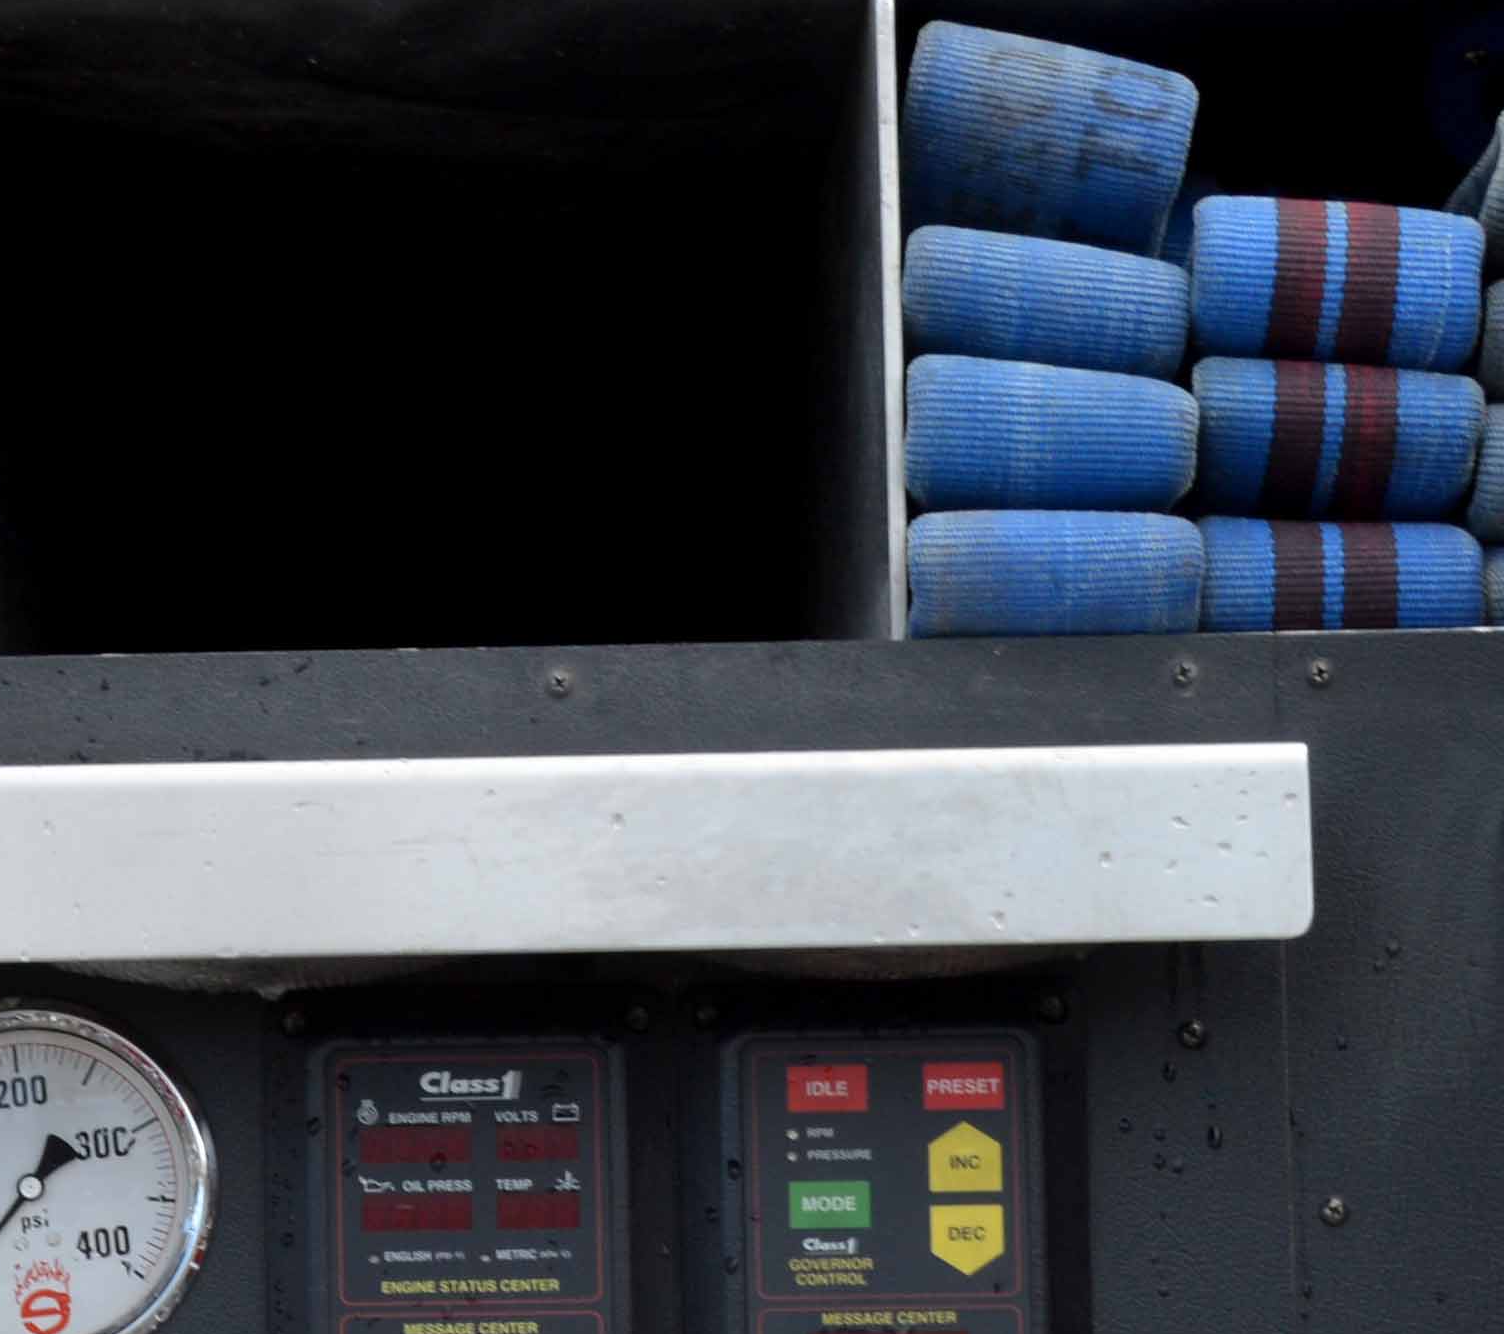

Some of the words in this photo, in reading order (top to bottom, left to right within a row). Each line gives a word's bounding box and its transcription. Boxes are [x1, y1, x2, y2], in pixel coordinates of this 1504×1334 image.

[806, 1080, 848, 1096] IDLE
[927, 1078, 1000, 1095] PRESET
[495, 1110, 538, 1123] VOLTS
[807, 1149, 873, 1161] PRESSURE
[949, 1155, 981, 1170] INC
[402, 1180, 425, 1192] OIL
[429, 1179, 472, 1192] PRESS
[496, 1179, 533, 1191] TEMP
[801, 1195, 856, 1211] MODE
[947, 1226, 986, 1241] DEC
[77, 1226, 131, 1259] 400
[789, 1258, 874, 1271] GOVERNOR
[381, 1279, 437, 1294] ENGINE
[440, 1279, 496, 1293] STATUS
[500, 1278, 560, 1293] CENTER
[796, 1272, 867, 1286] CONTROL
[821, 1311, 893, 1326] MESSAGE
[897, 1310, 957, 1324] CENTER
[479, 1321, 538, 1334] CENTER
